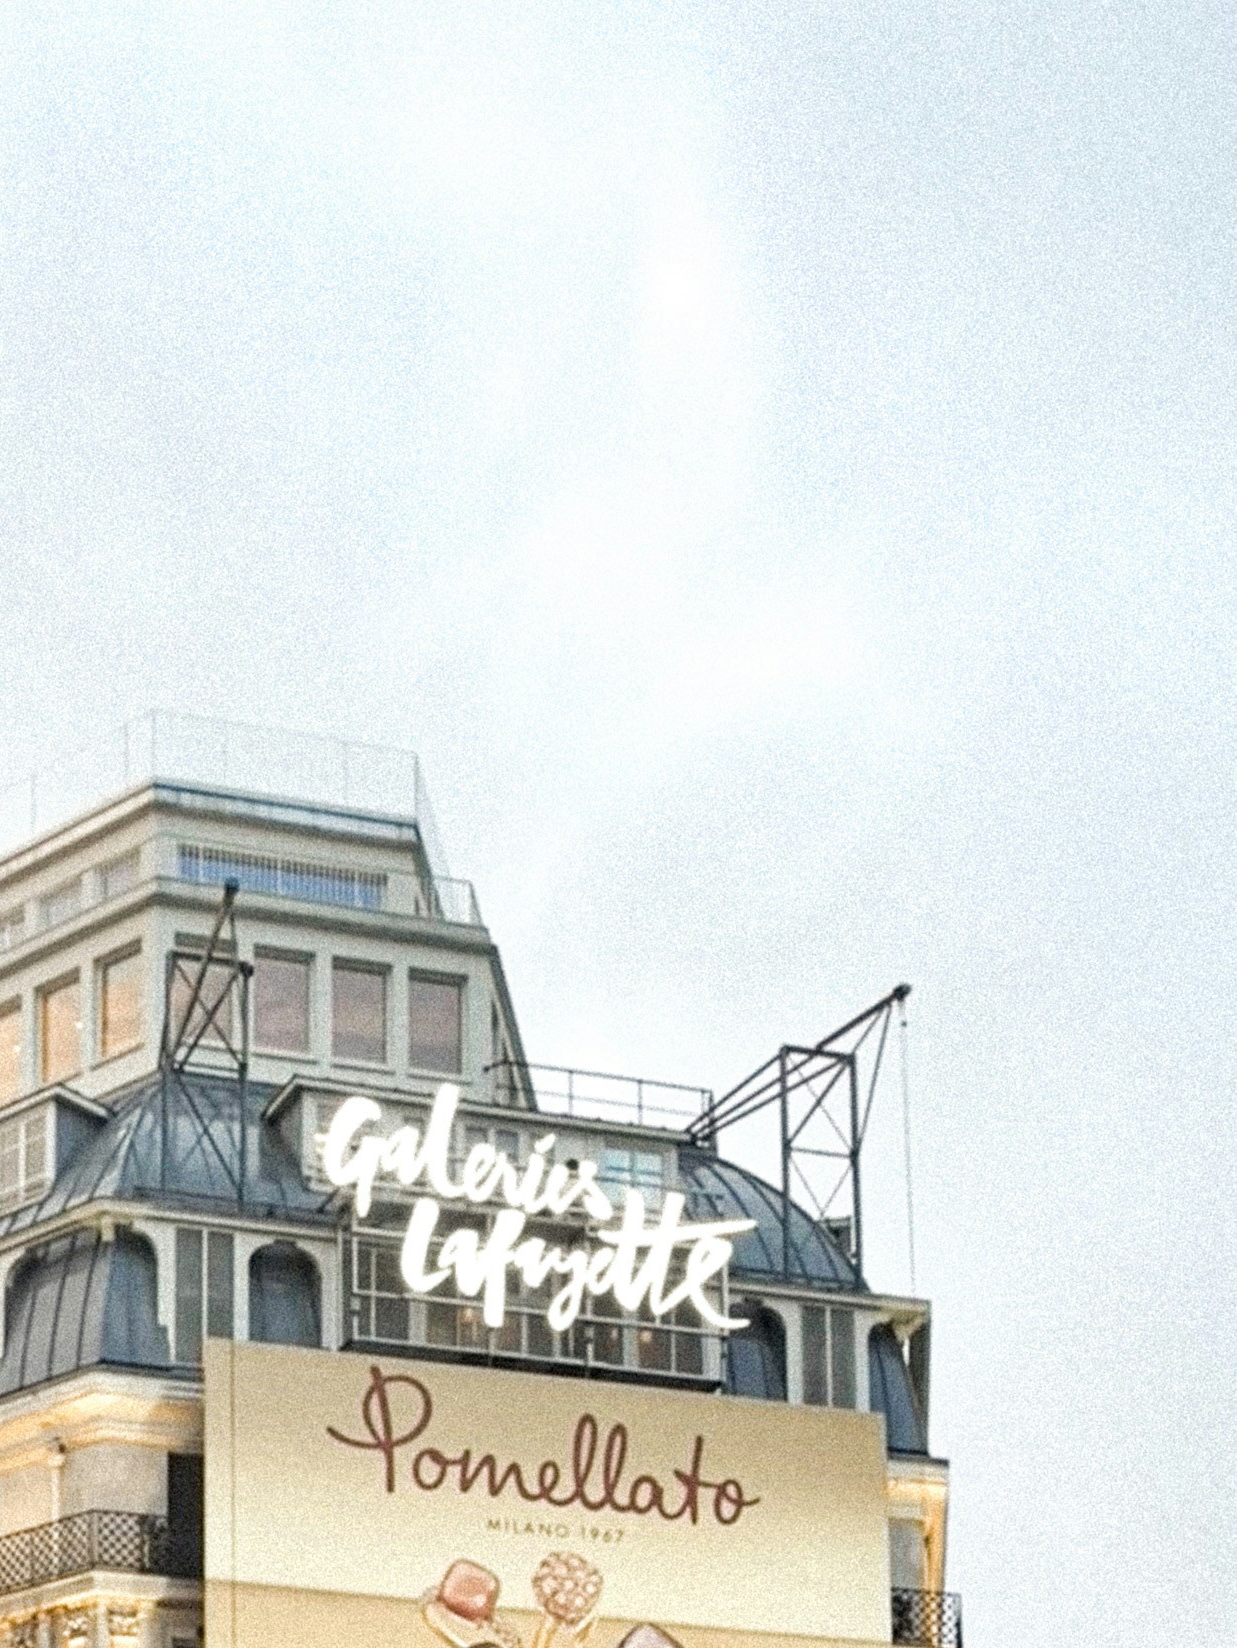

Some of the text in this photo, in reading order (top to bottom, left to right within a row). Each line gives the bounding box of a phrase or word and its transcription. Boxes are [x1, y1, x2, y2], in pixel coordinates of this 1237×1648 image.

[317, 1083, 614, 1220] Galeries
[400, 1188, 758, 1332] Lafayette
[326, 1364, 761, 1526] Pomellato
[487, 1518, 624, 1544] MILANO 1967
